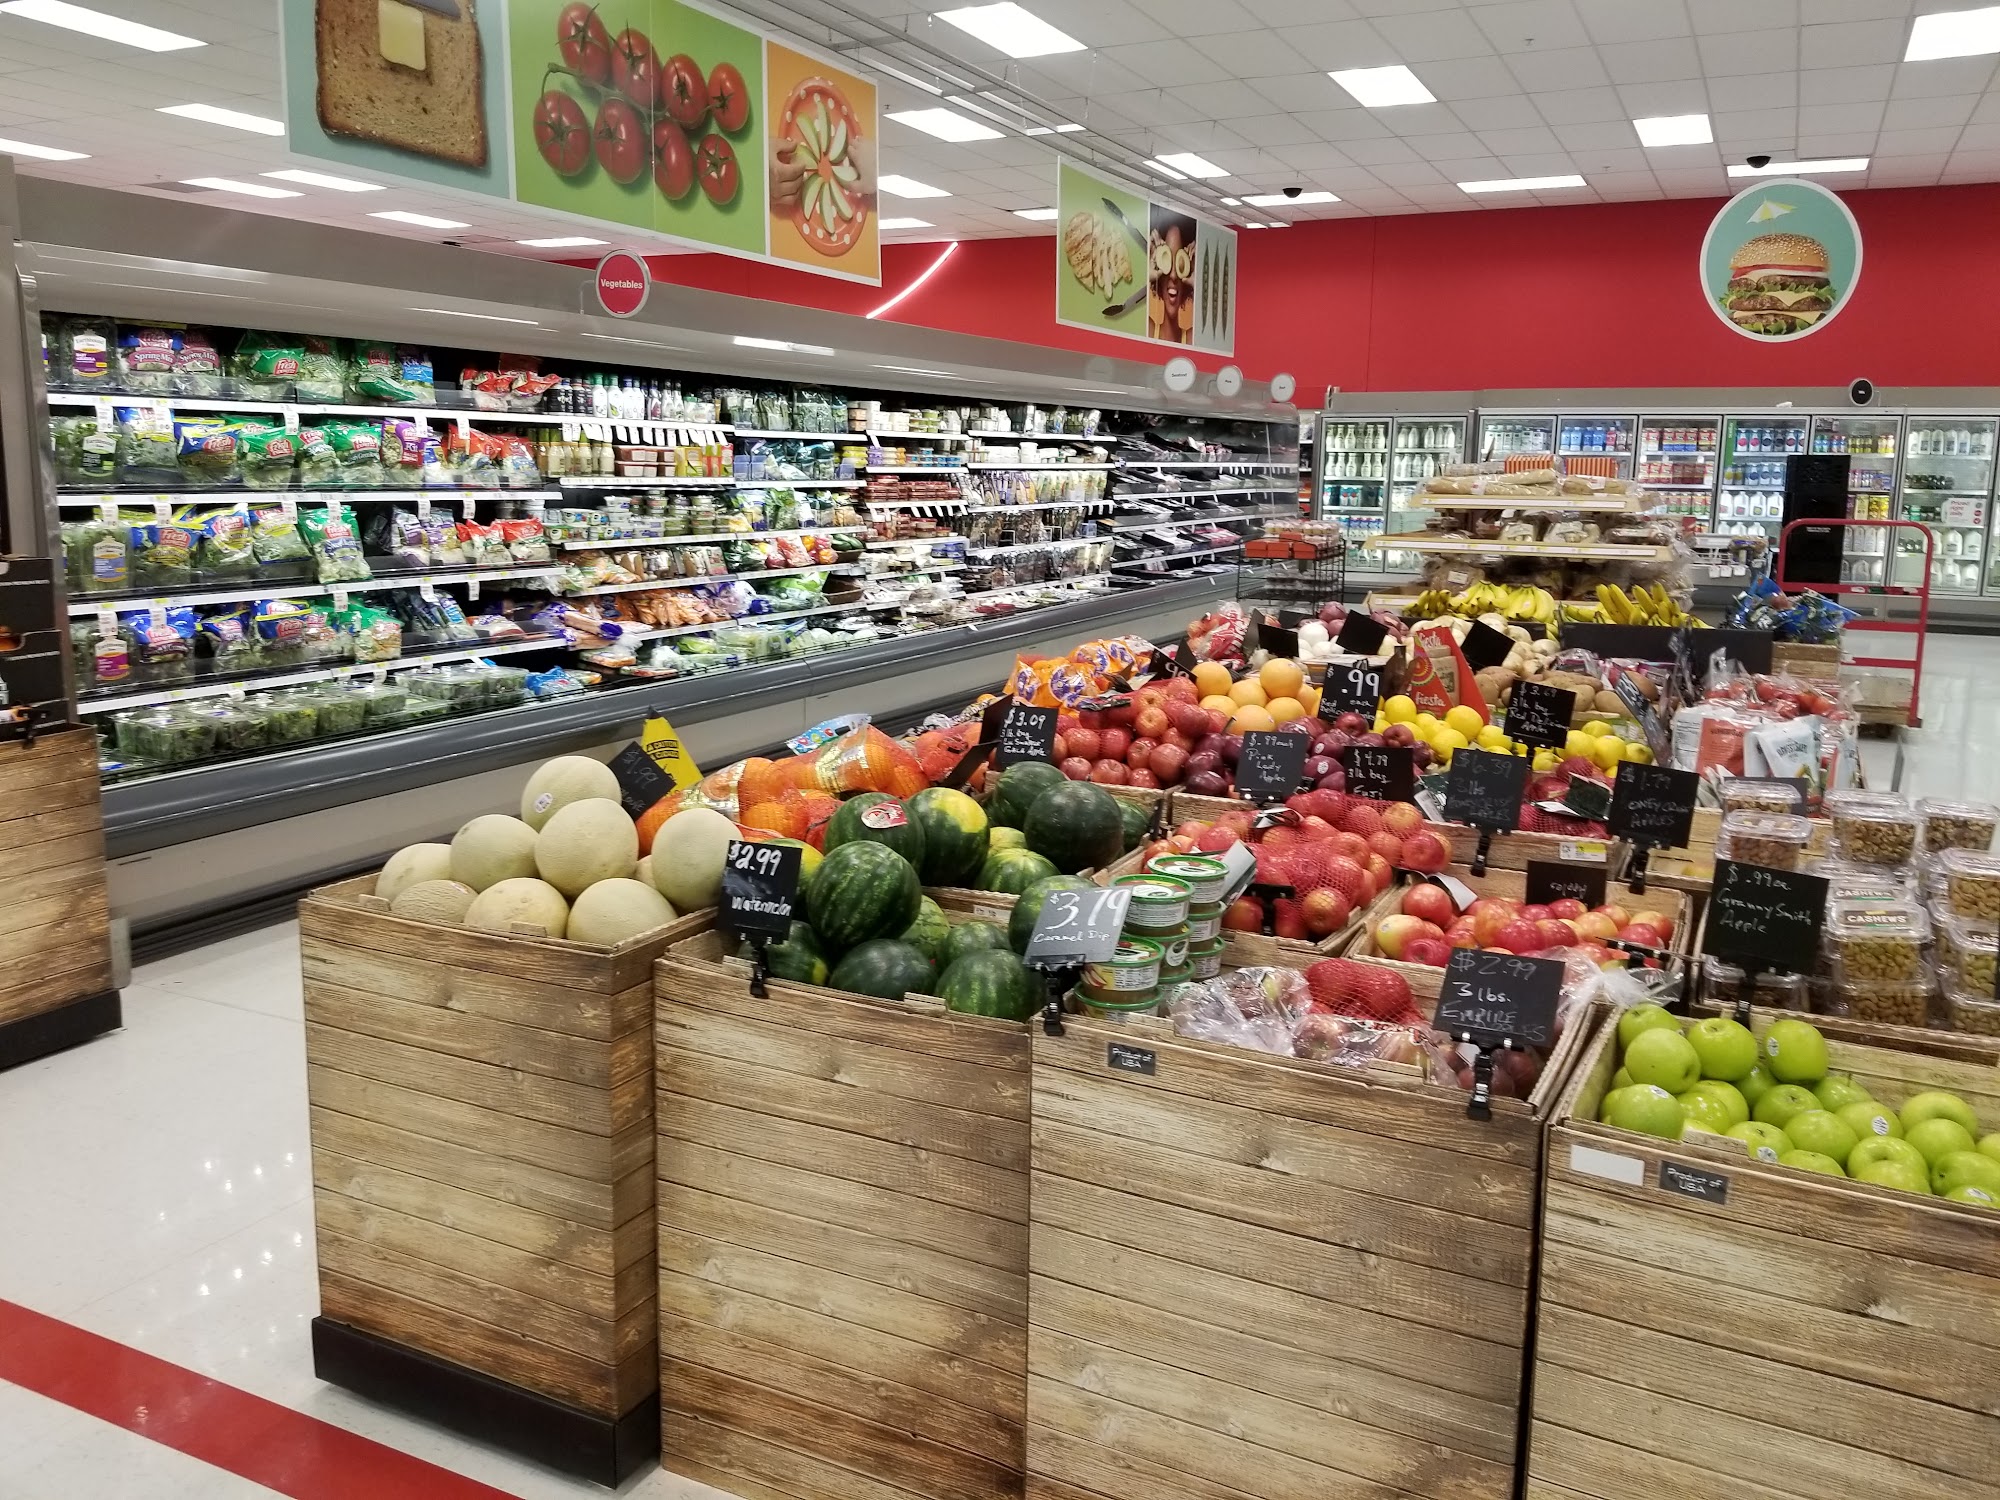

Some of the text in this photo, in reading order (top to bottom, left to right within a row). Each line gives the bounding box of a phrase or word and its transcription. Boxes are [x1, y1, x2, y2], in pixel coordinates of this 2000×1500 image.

[600, 278, 643, 290] Vegetables
[134, 352, 161, 363] Spring
[277, 359, 297, 370] Fresh
[208, 438, 232, 449] Fresh
[161, 529, 188, 542] Fresh
[1415, 691, 1447, 707] fiesta
[1003, 707, 1047, 730] $3.09
[1245, 747, 1274, 761] Pink
[1256, 760, 1282, 772] Lady
[728, 840, 783, 877] $2.99
[1836, 889, 1892, 898] CASHEWS
[1045, 888, 1132, 930] $3.79
[1716, 887, 1812, 926] Granny Smith
[1719, 908, 1768, 935] Apple
[1846, 914, 1908, 924] CASHEWS
[1087, 930, 1111, 941] Dip
[1450, 949, 1538, 981] $2.99
[1112, 1047, 1153, 1062] Product of
[1121, 1058, 1142, 1069] USA
[1667, 1167, 1724, 1188] Product of
[1679, 1180, 1707, 1195] USA
